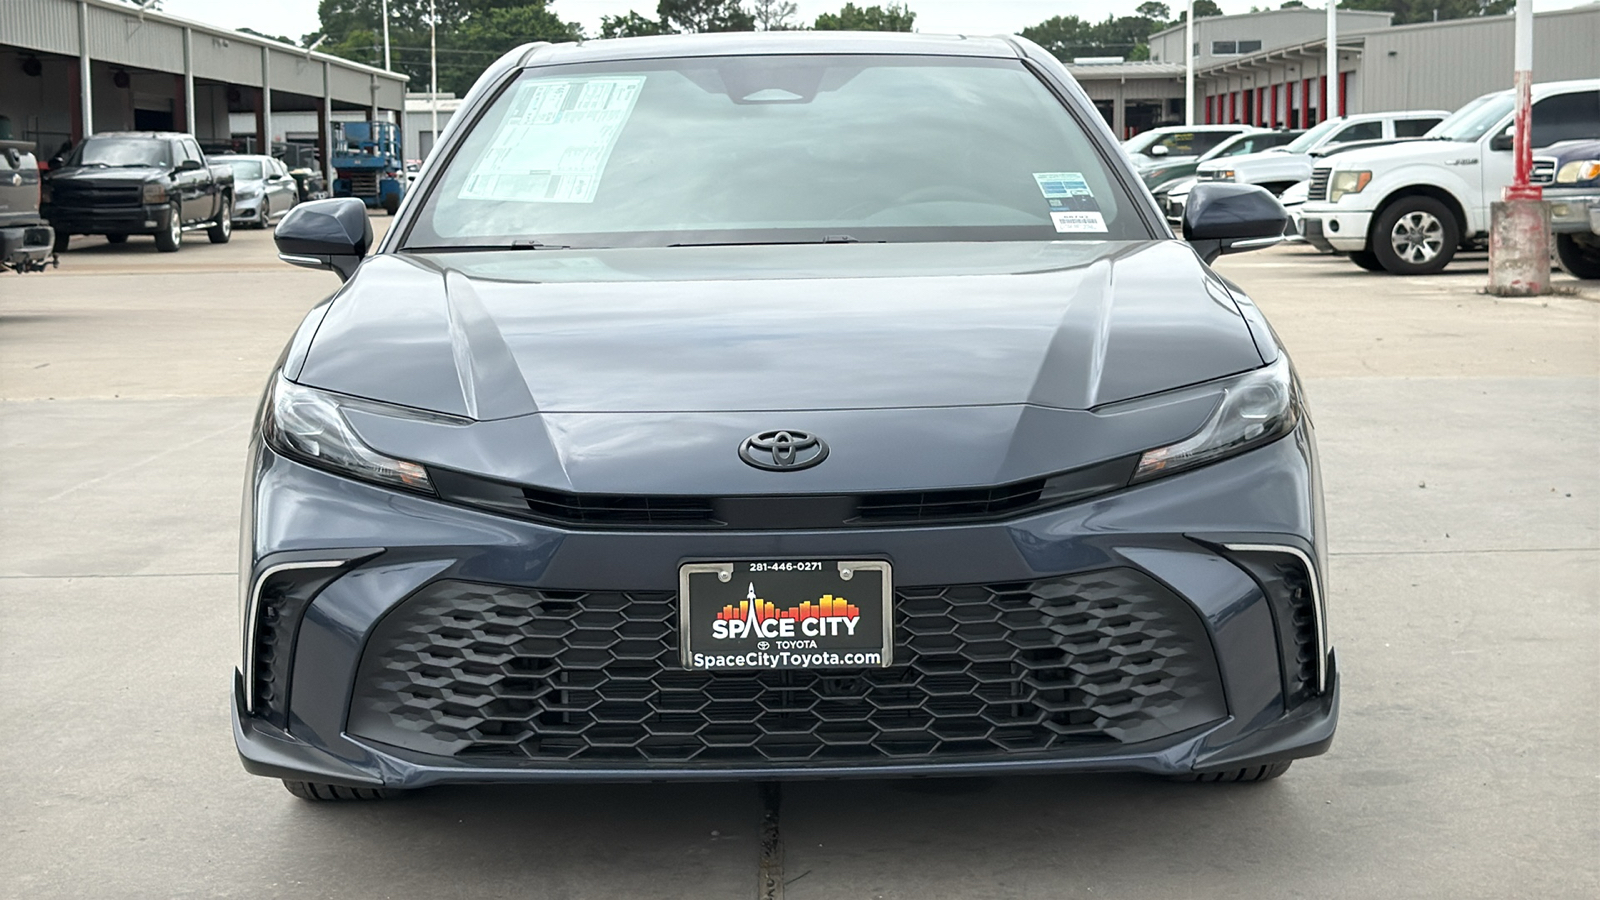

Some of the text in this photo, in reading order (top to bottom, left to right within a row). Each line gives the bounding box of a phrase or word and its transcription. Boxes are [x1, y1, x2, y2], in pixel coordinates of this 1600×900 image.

[749, 561, 823, 572] 281-446-0271
[711, 616, 861, 640] SPACE CITY
[775, 639, 818, 650] TOYOTA
[693, 651, 881, 669] SpaceCityToyota.com
